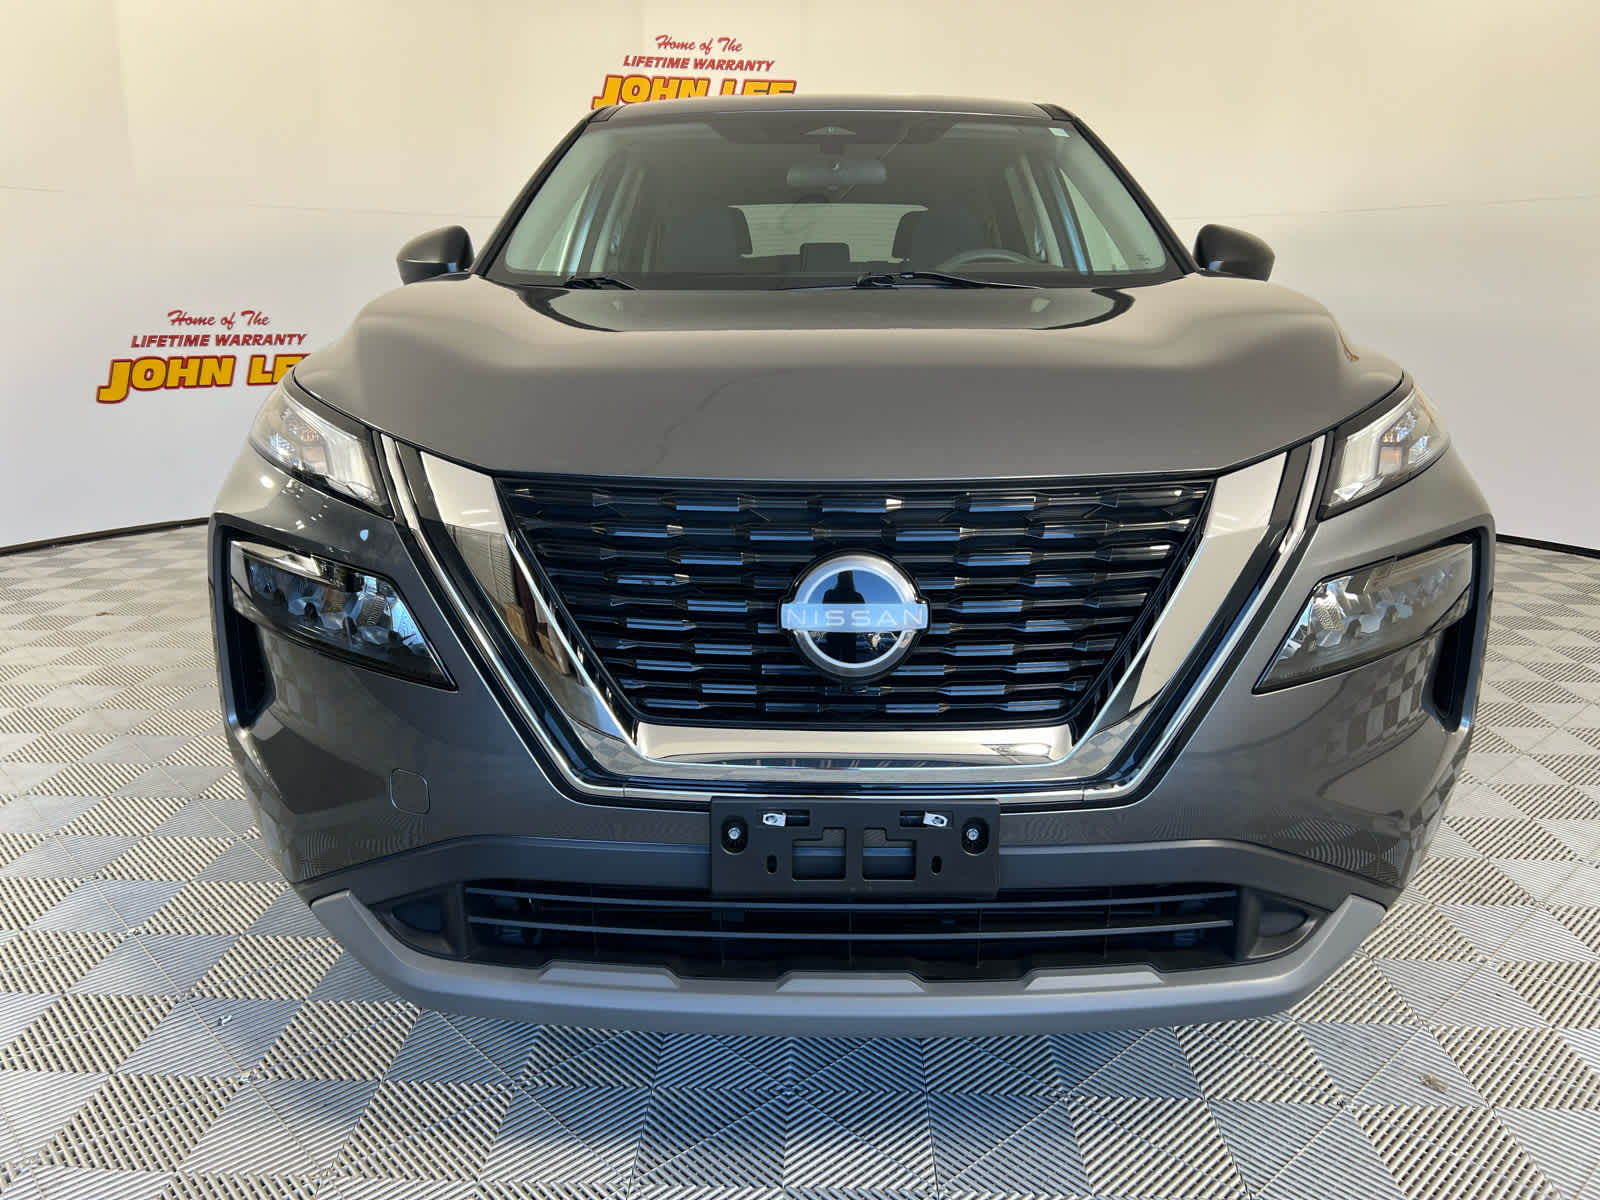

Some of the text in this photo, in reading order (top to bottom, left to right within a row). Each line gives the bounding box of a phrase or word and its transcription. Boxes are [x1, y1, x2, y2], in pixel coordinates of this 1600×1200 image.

[655, 35, 743, 56] Home of The
[623, 55, 775, 73] LIFETIME WARRANTY
[591, 74, 711, 111] JOHN
[168, 310, 270, 331] Home of The
[131, 333, 308, 349] LIFETIME WARRANTY
[96, 355, 236, 405] JOHN
[786, 607, 924, 628] NISSAN
